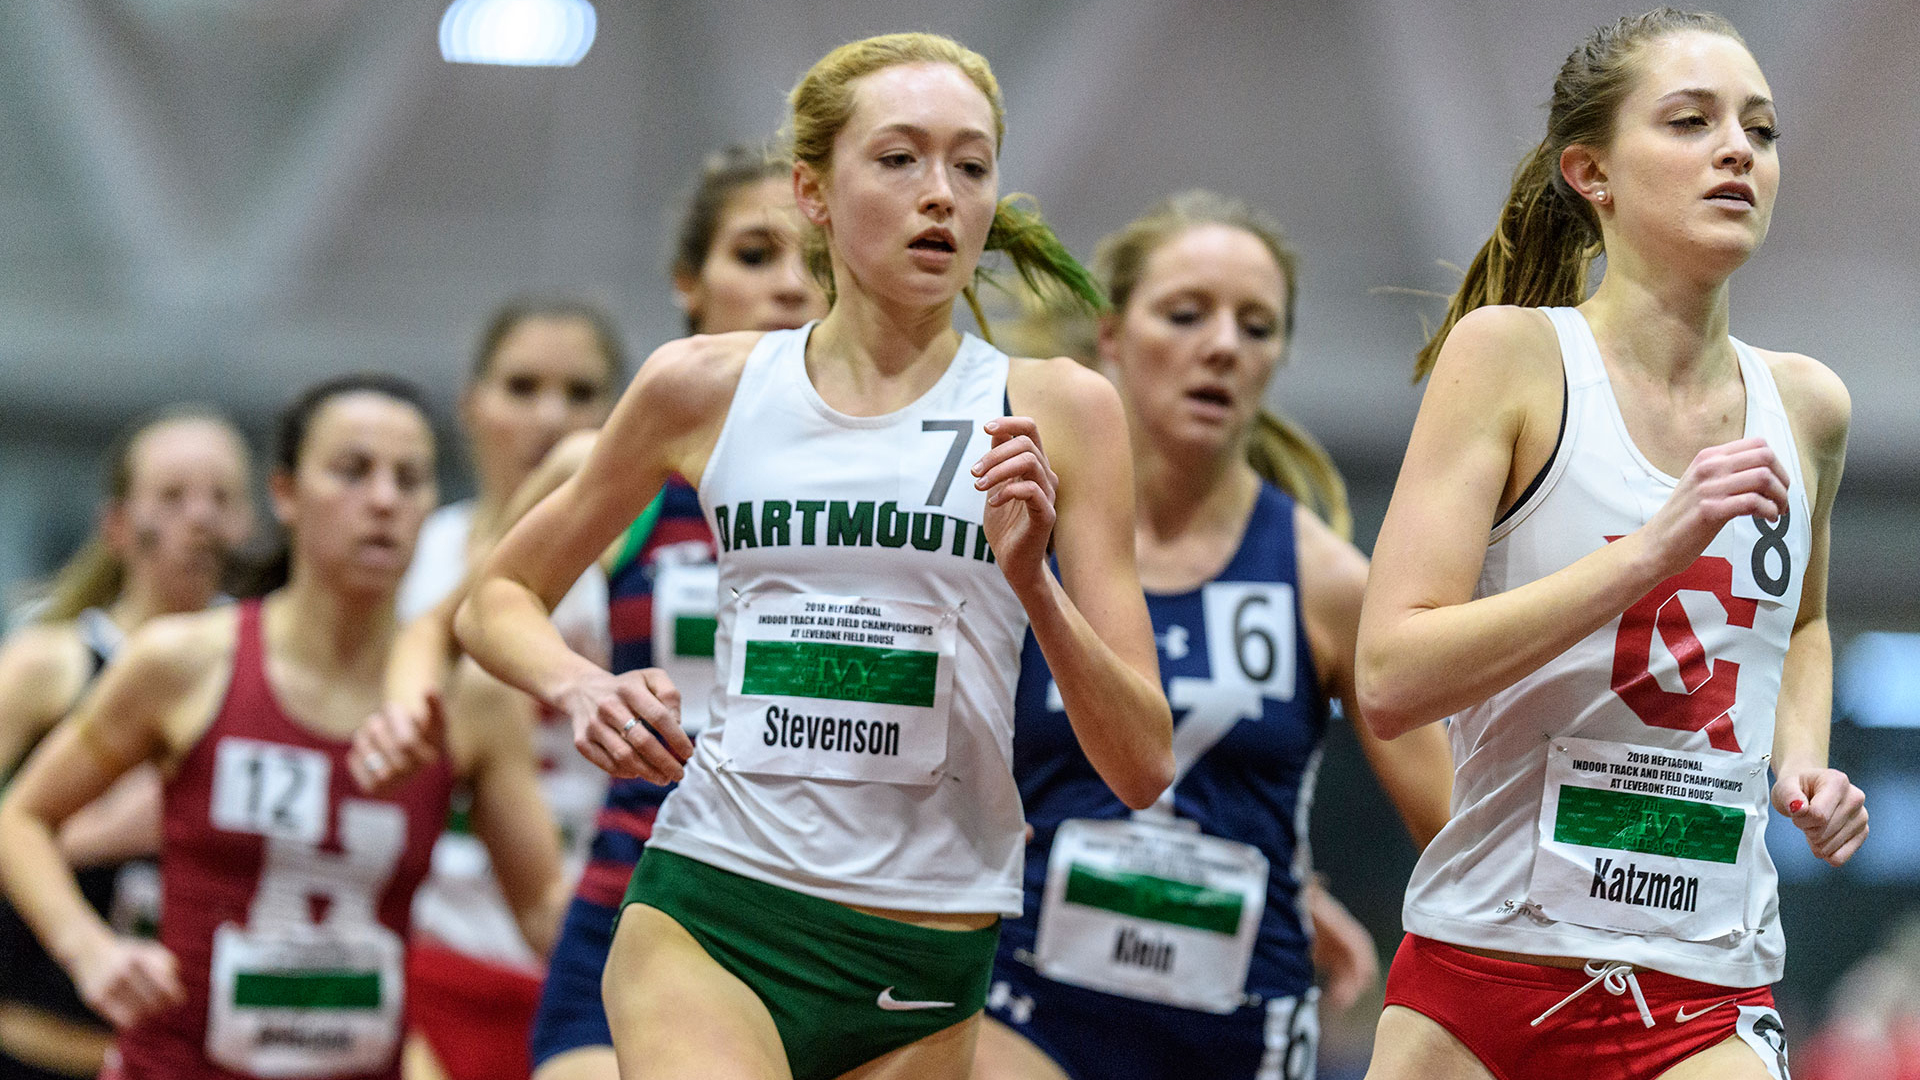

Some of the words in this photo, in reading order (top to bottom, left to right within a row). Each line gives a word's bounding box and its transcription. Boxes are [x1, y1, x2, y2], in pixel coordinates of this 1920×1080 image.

[921, 419, 974, 507] 7
[1751, 507, 1791, 597] 8
[805, 602, 826, 613] 2018
[828, 604, 882, 617] HEPTAGONAL
[758, 615, 788, 625] INDOOR
[790, 616, 816, 626] TRACK
[817, 617, 835, 626] AND
[837, 618, 860, 629] FIELD
[861, 620, 934, 636] CHAMPIONSHIPS
[791, 628, 801, 638] AT
[802, 629, 842, 641] LEVERONE
[843, 631, 865, 643] FIELD
[867, 633, 895, 645] HOUSE
[1231, 594, 1277, 682] 6
[818, 656, 877, 686] IVY
[763, 705, 900, 756] Stevenson
[1572, 759, 1607, 773] INDOOR
[1609, 763, 1638, 777] TRACK
[1640, 767, 1658, 780] AND
[1659, 770, 1682, 784] FIELD
[1683, 773, 1743, 793] CHAMPIONSHIPS
[1627, 751, 1649, 764] 2018
[1651, 754, 1703, 771] HEPTAGONAL
[245, 757, 307, 829] 12
[1610, 778, 1622, 789] AT
[1623, 779, 1665, 795] LEVERONE
[1666, 786, 1687, 798] FIELD
[1688, 788, 1714, 801] HOUSE
[1638, 810, 1696, 840] IVY
[1635, 835, 1690, 855] LEAGUE
[1589, 857, 1699, 912] Katzman
